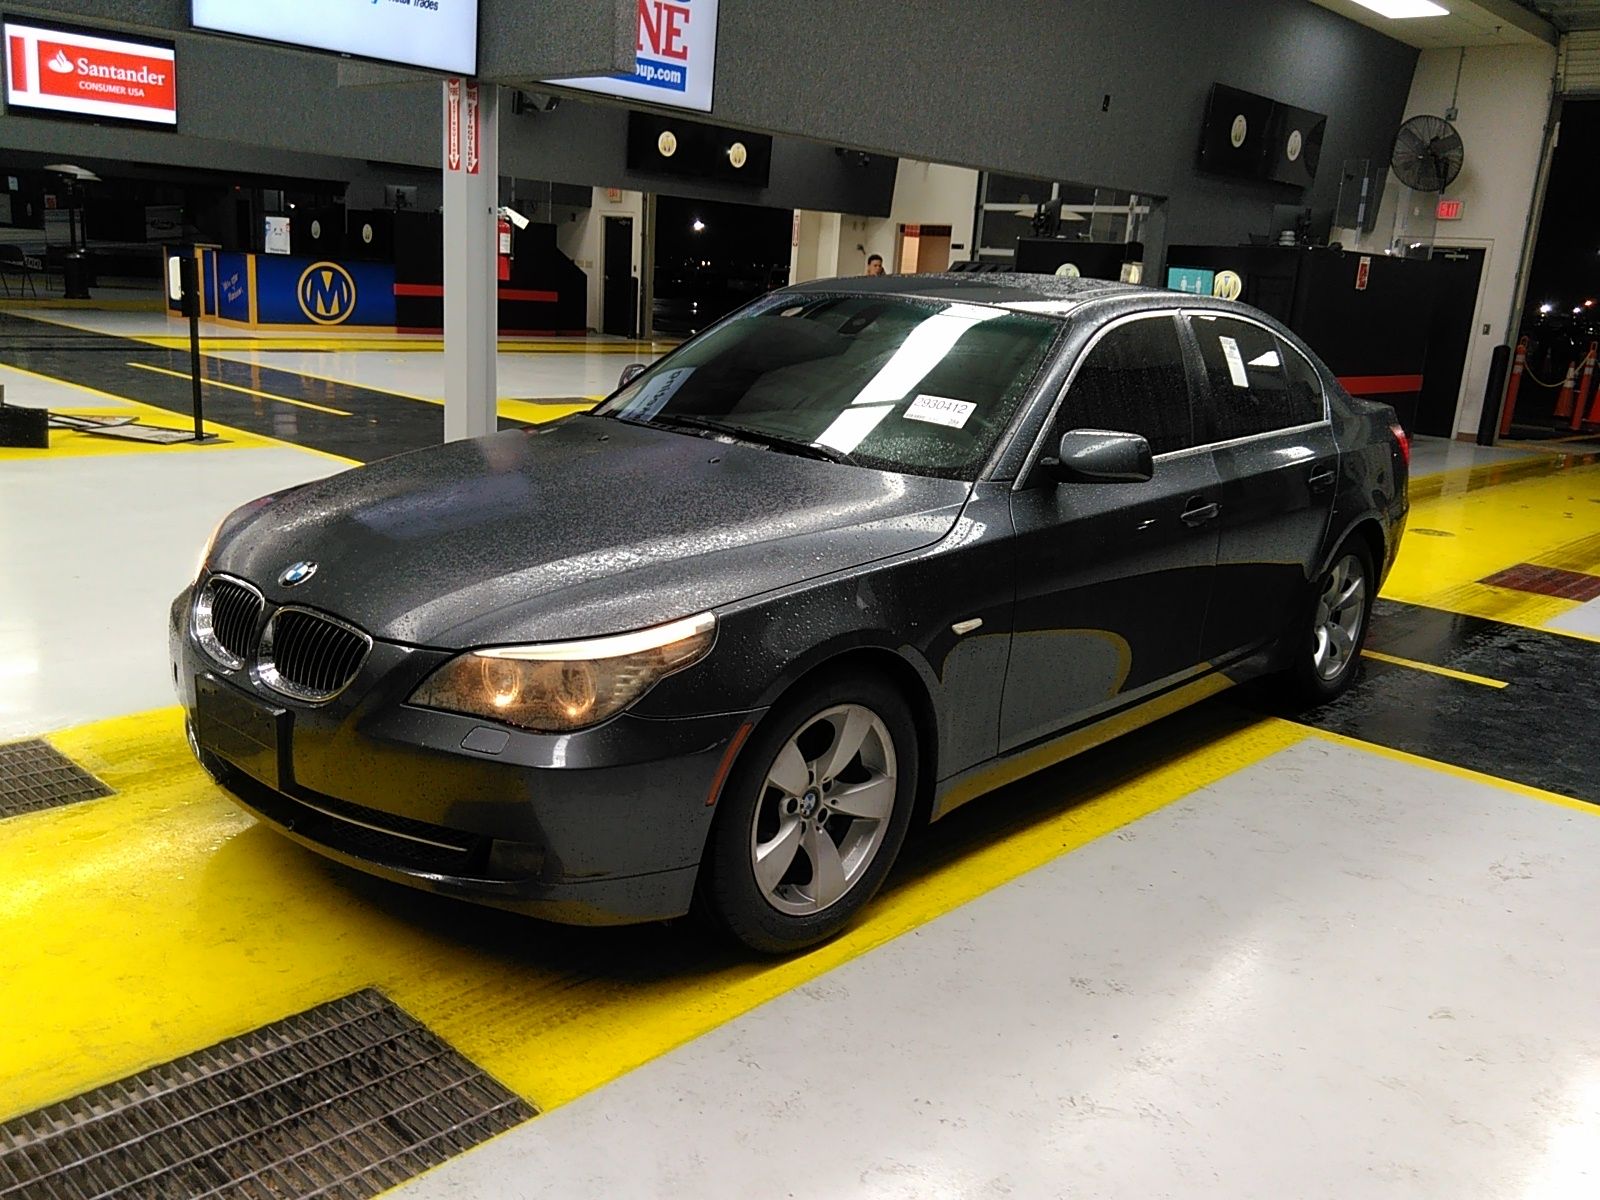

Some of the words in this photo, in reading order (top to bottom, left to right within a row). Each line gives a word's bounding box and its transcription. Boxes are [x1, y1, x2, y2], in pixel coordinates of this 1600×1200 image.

[77, 57, 166, 86] Santander
[79, 80, 126, 95] CONSUMER
[127, 87, 145, 98] USA
[913, 396, 969, 415] 2930412
